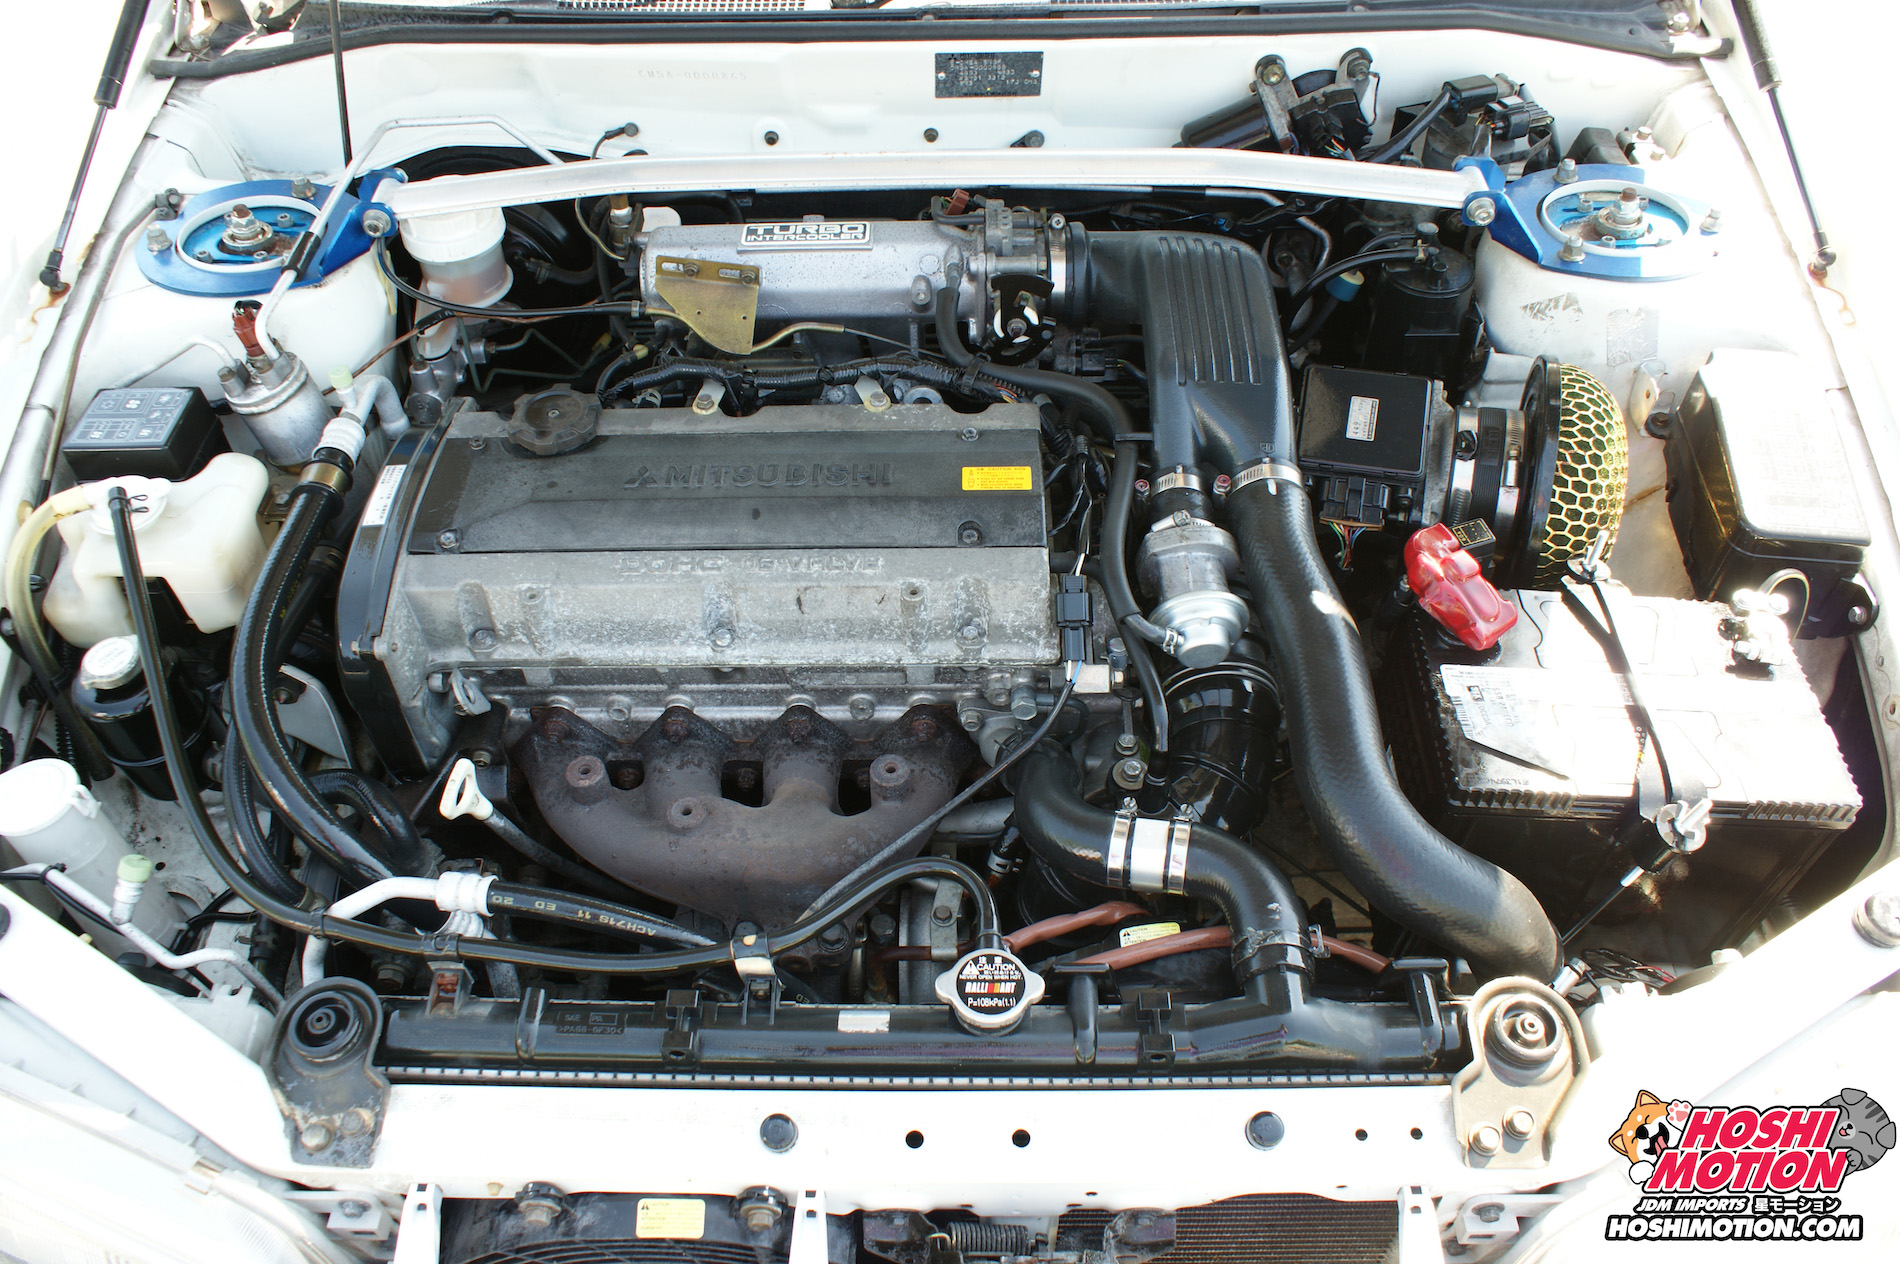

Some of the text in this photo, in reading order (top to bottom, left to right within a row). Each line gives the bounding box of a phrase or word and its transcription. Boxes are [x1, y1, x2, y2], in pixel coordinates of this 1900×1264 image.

[749, 223, 865, 235] TURBO
[746, 233, 864, 242] INTERCOOLER
[664, 463, 892, 488] MITSUBISHI
[618, 556, 727, 575] DOHC
[491, 895, 657, 937] ACH71S 11 ED 20
[976, 963, 1016, 971] CAUTION
[965, 981, 1017, 994] RALLIART
